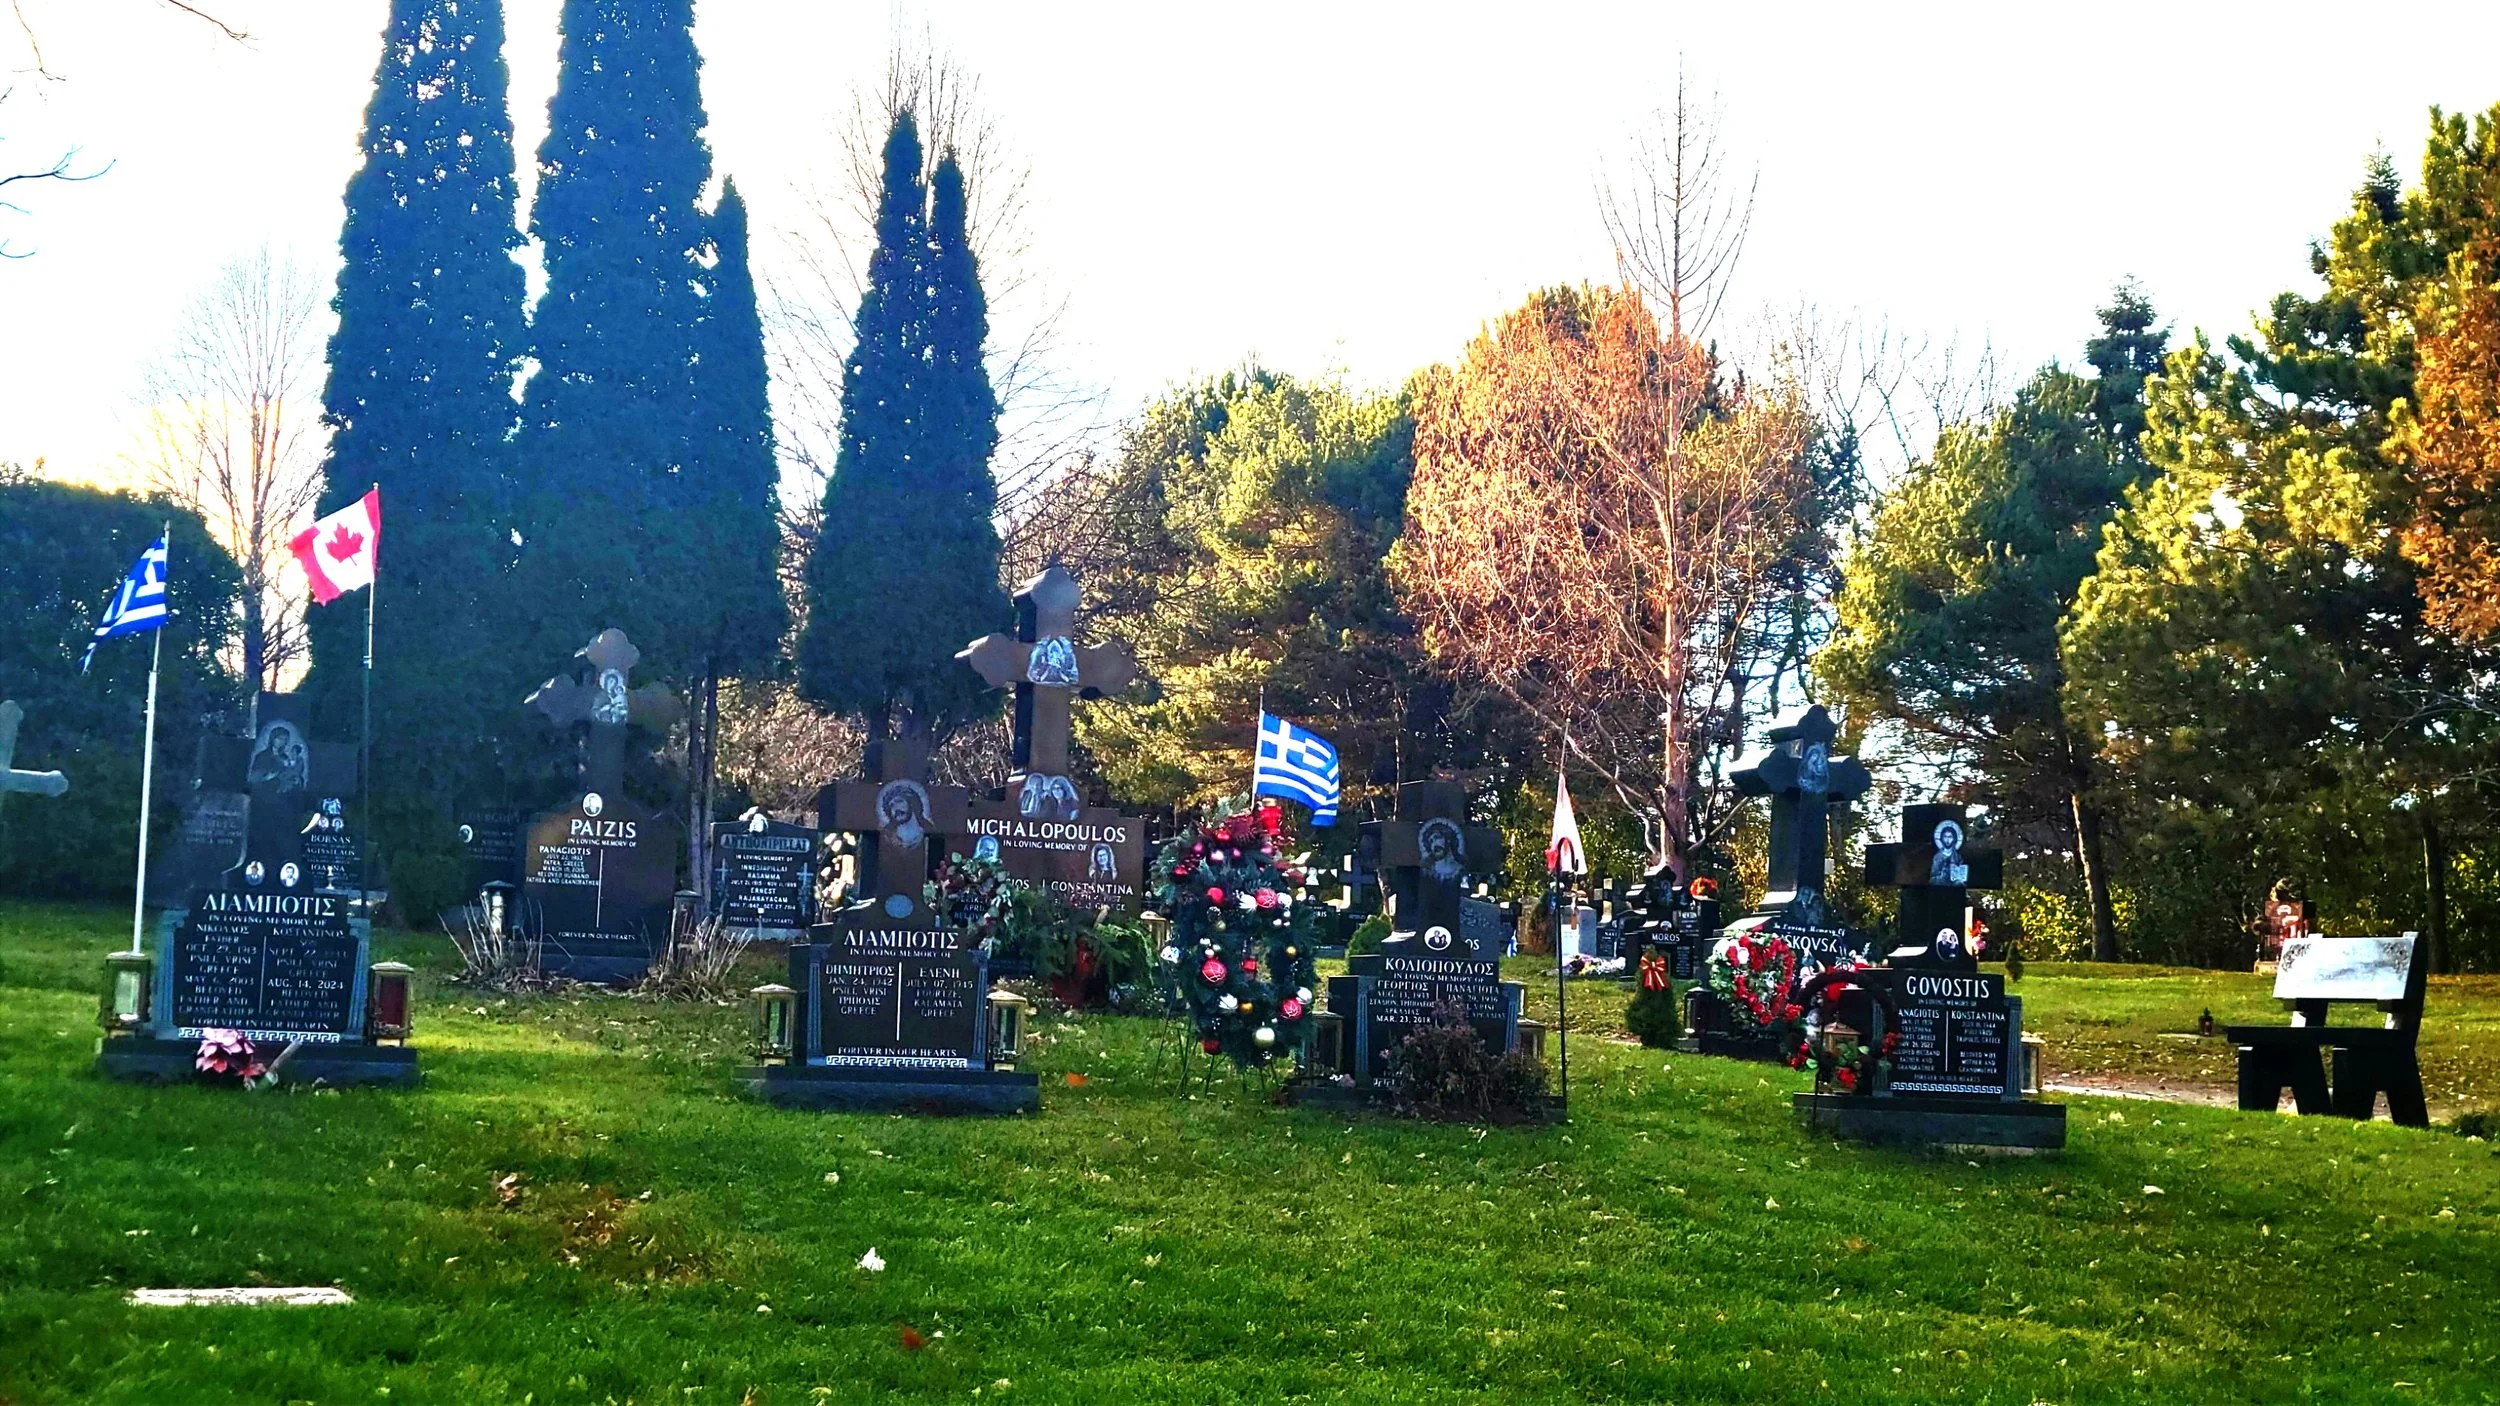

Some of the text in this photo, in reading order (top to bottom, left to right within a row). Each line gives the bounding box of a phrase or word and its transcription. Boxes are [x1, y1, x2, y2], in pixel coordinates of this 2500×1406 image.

[570, 818, 637, 839] PAIZIS
[966, 818, 1126, 843] MICHALOPOULOS
[576, 838, 600, 846] LOVING
[601, 839, 627, 847] MEMORY
[1003, 839, 1089, 851] IN LOVING MEMORY OF
[311, 863, 345, 872] IOANA
[209, 914, 327, 926] IN LOVING MEMORY OF
[1651, 933, 1680, 942] MOROS
[849, 948, 860, 956] IN
[862, 948, 896, 957] LOVING
[899, 949, 937, 958] MEMORY
[1404, 973, 1435, 981] LOVING
[1437, 974, 1472, 982] MEMORY
[317, 979, 344, 990] 2024
[1906, 976, 1990, 999] GOVOSTIS
[1951, 1009, 2006, 1021] KONSTANTINA
[838, 1046, 957, 1057] FOREVER IN OUR HEARTS
